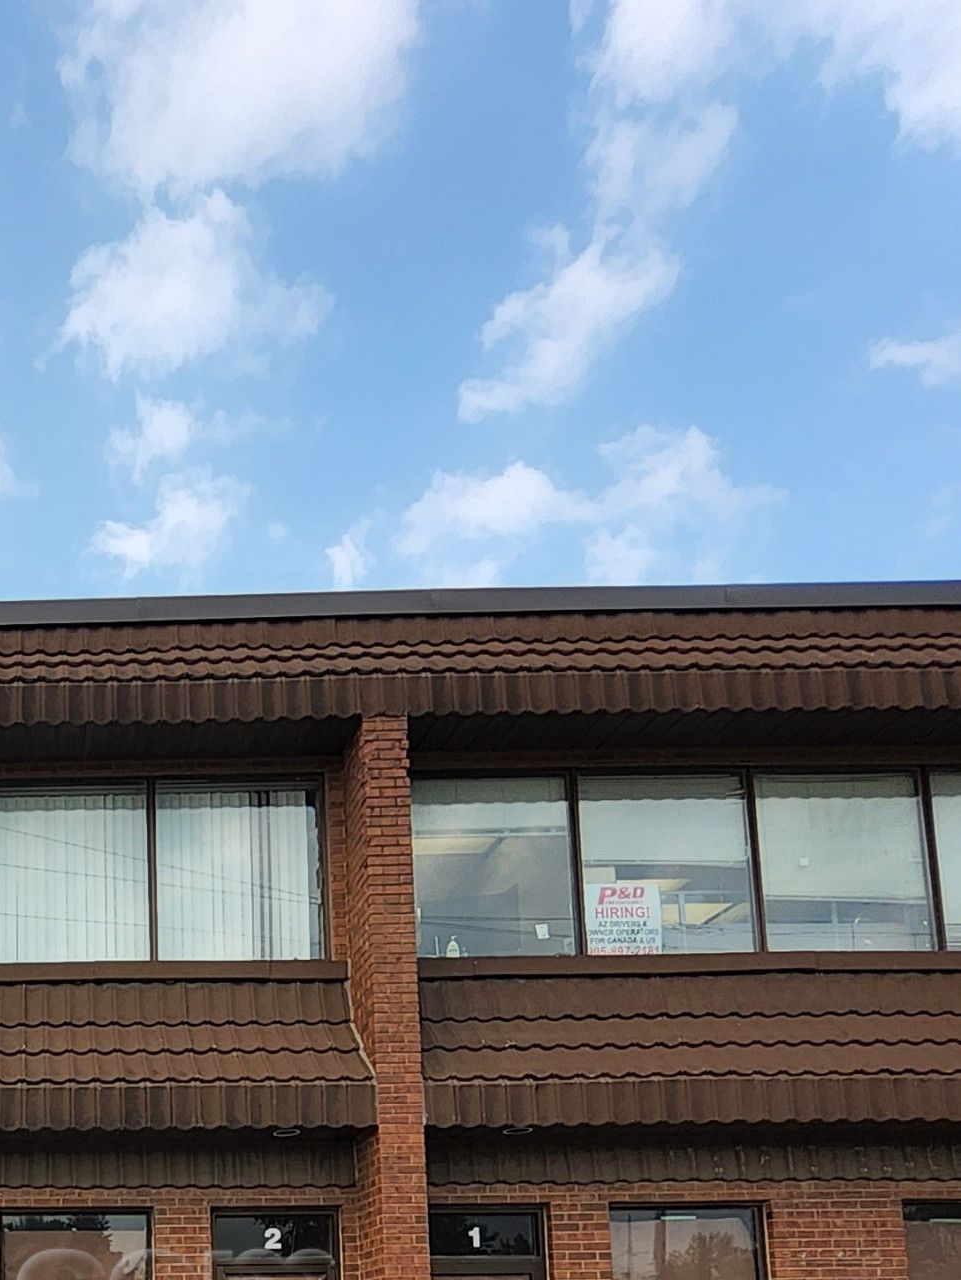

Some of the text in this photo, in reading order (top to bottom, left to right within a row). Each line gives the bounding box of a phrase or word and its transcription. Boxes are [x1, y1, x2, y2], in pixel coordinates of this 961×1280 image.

[597, 886, 645, 905] P&D
[595, 907, 650, 918] HIRING!
[264, 1228, 282, 1249] 2
[468, 1226, 480, 1247] 1
